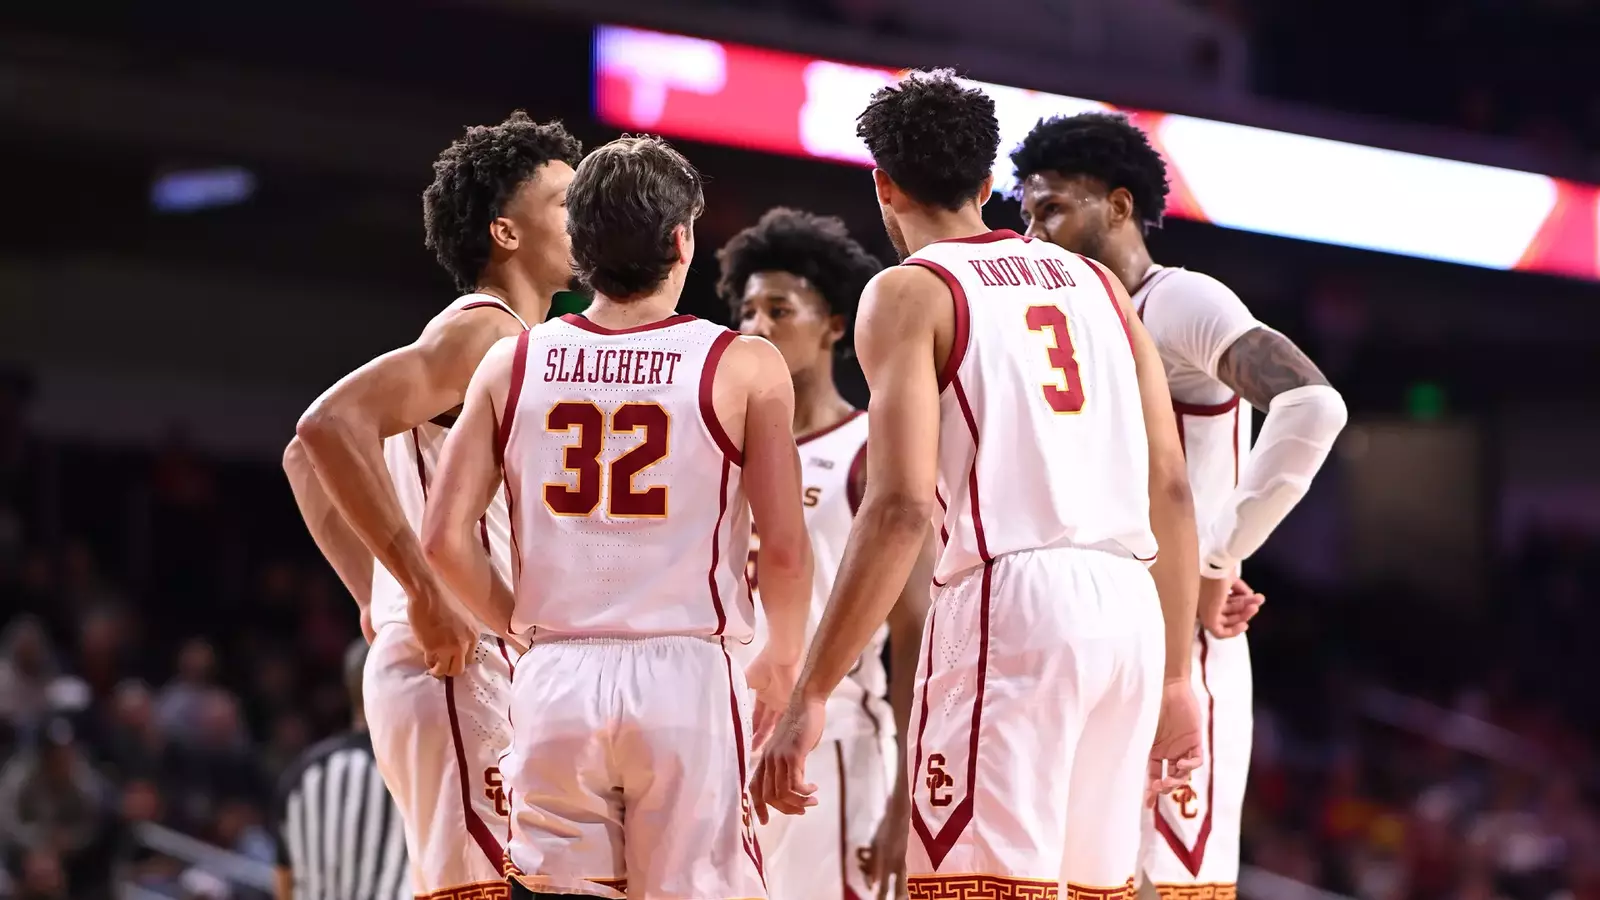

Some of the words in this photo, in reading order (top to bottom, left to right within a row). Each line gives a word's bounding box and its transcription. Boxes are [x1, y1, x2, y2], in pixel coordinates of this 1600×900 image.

[543, 347, 682, 385] SLAJCHERT
[1025, 304, 1086, 415] 3
[542, 400, 671, 519] 32
